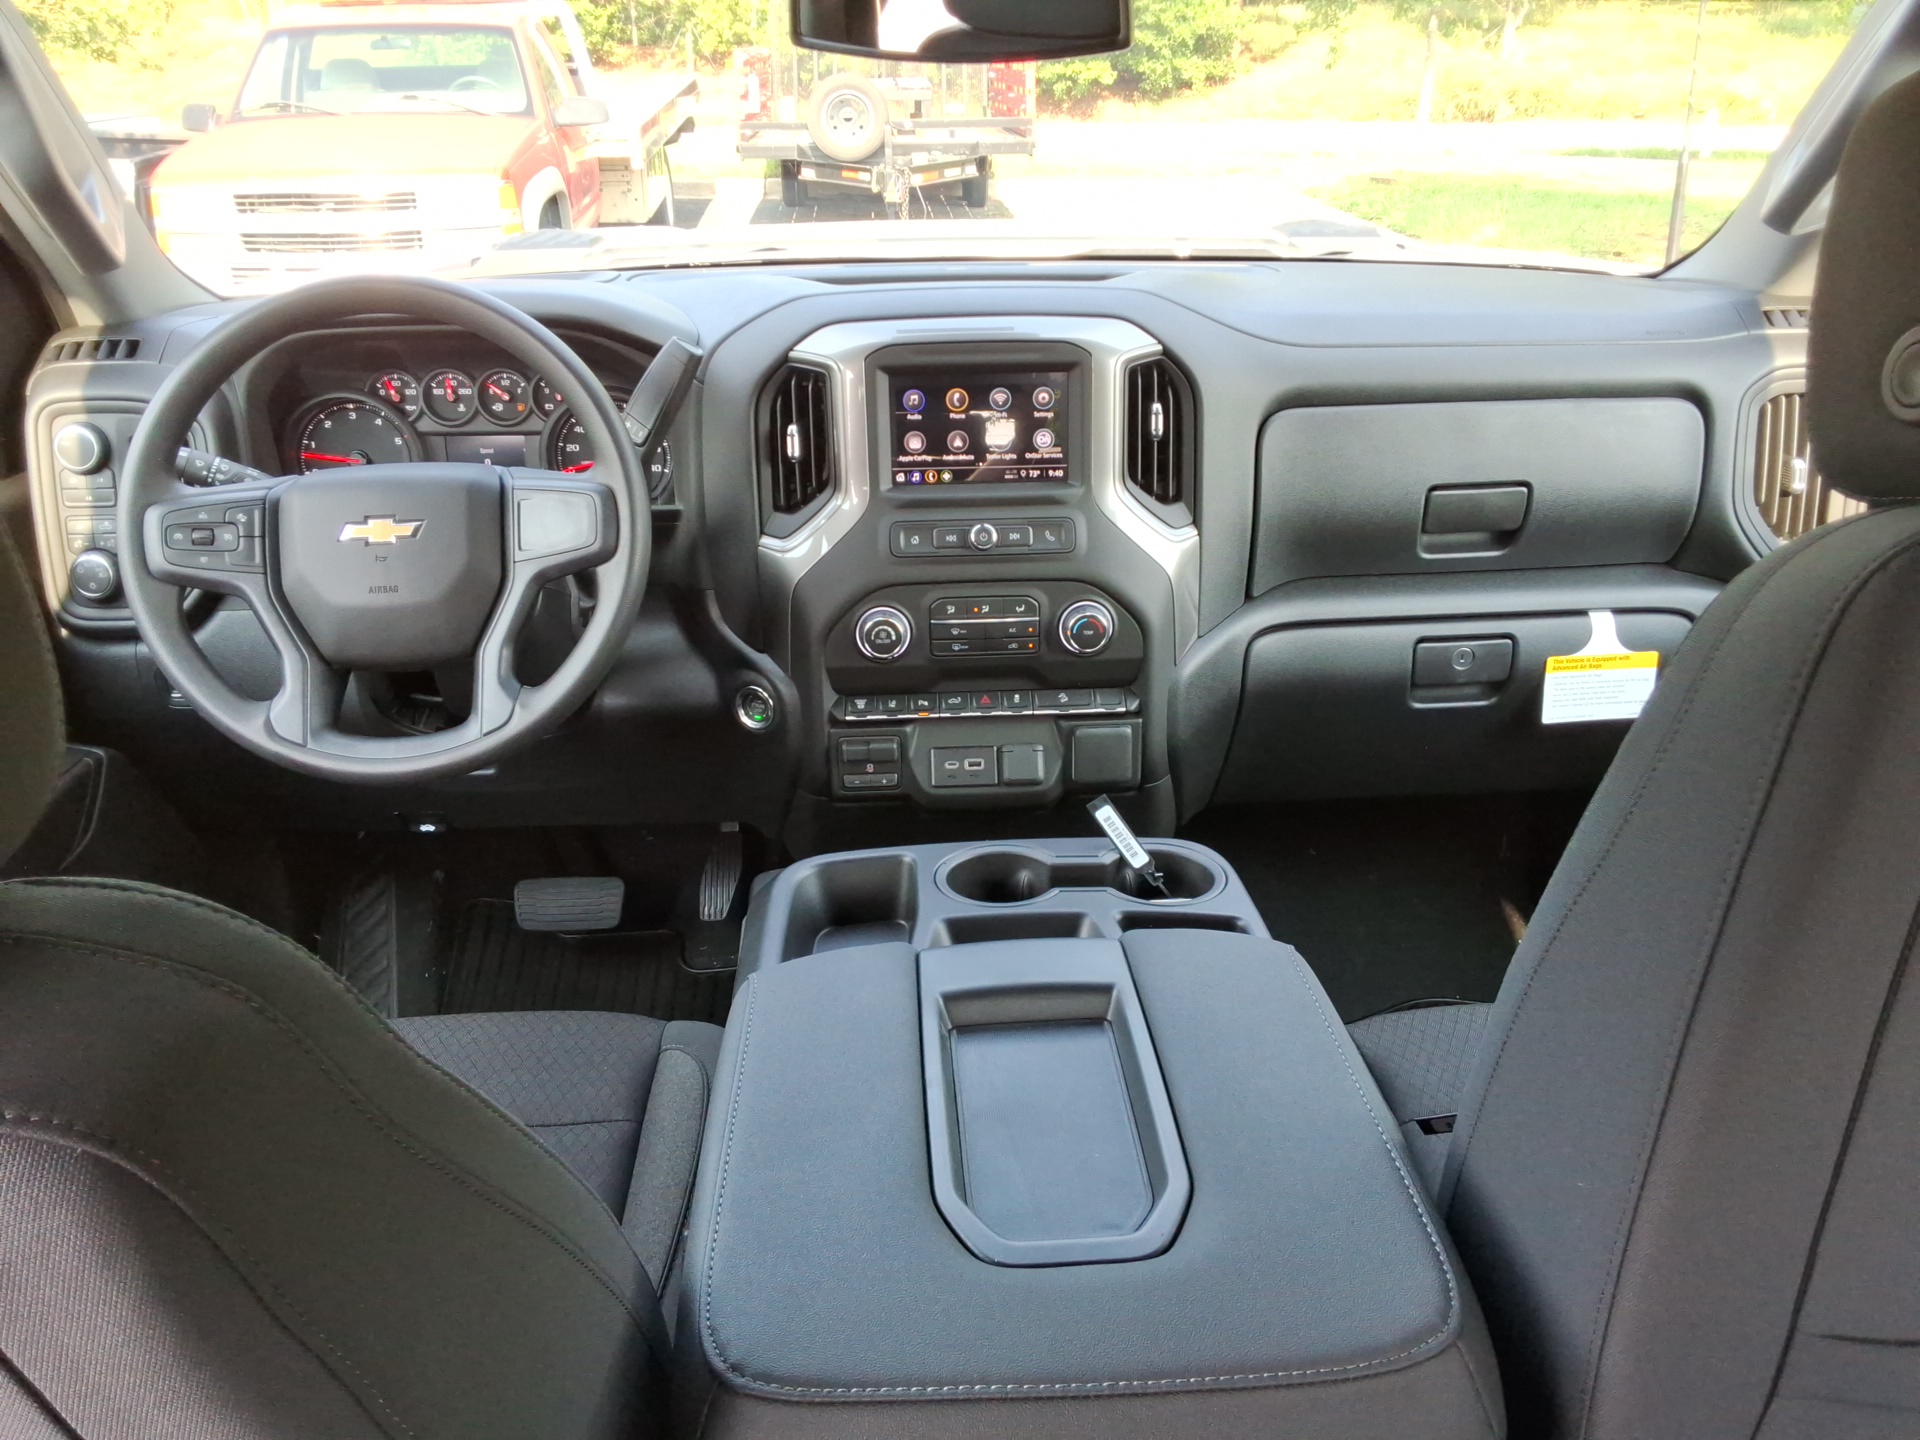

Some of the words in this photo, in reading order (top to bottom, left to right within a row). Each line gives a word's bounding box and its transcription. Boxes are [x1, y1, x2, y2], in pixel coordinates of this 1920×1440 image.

[379, 388, 386, 396] 0
[458, 387, 472, 395] 260
[517, 387, 523, 395] F
[348, 411, 357, 420] 3
[1033, 410, 1055, 418] Settings
[324, 420, 333, 429] 2
[374, 418, 383, 426] 4
[310, 441, 316, 449] 1
[394, 437, 403, 445] 5
[566, 443, 580, 452] 20
[1001, 452, 1018, 460] Lights
[1028, 469, 1042, 478] 73°
[1048, 469, 1064, 477] 9:40
[368, 585, 399, 594] AIRBAG
[1592, 655, 1618, 663] Equipped
